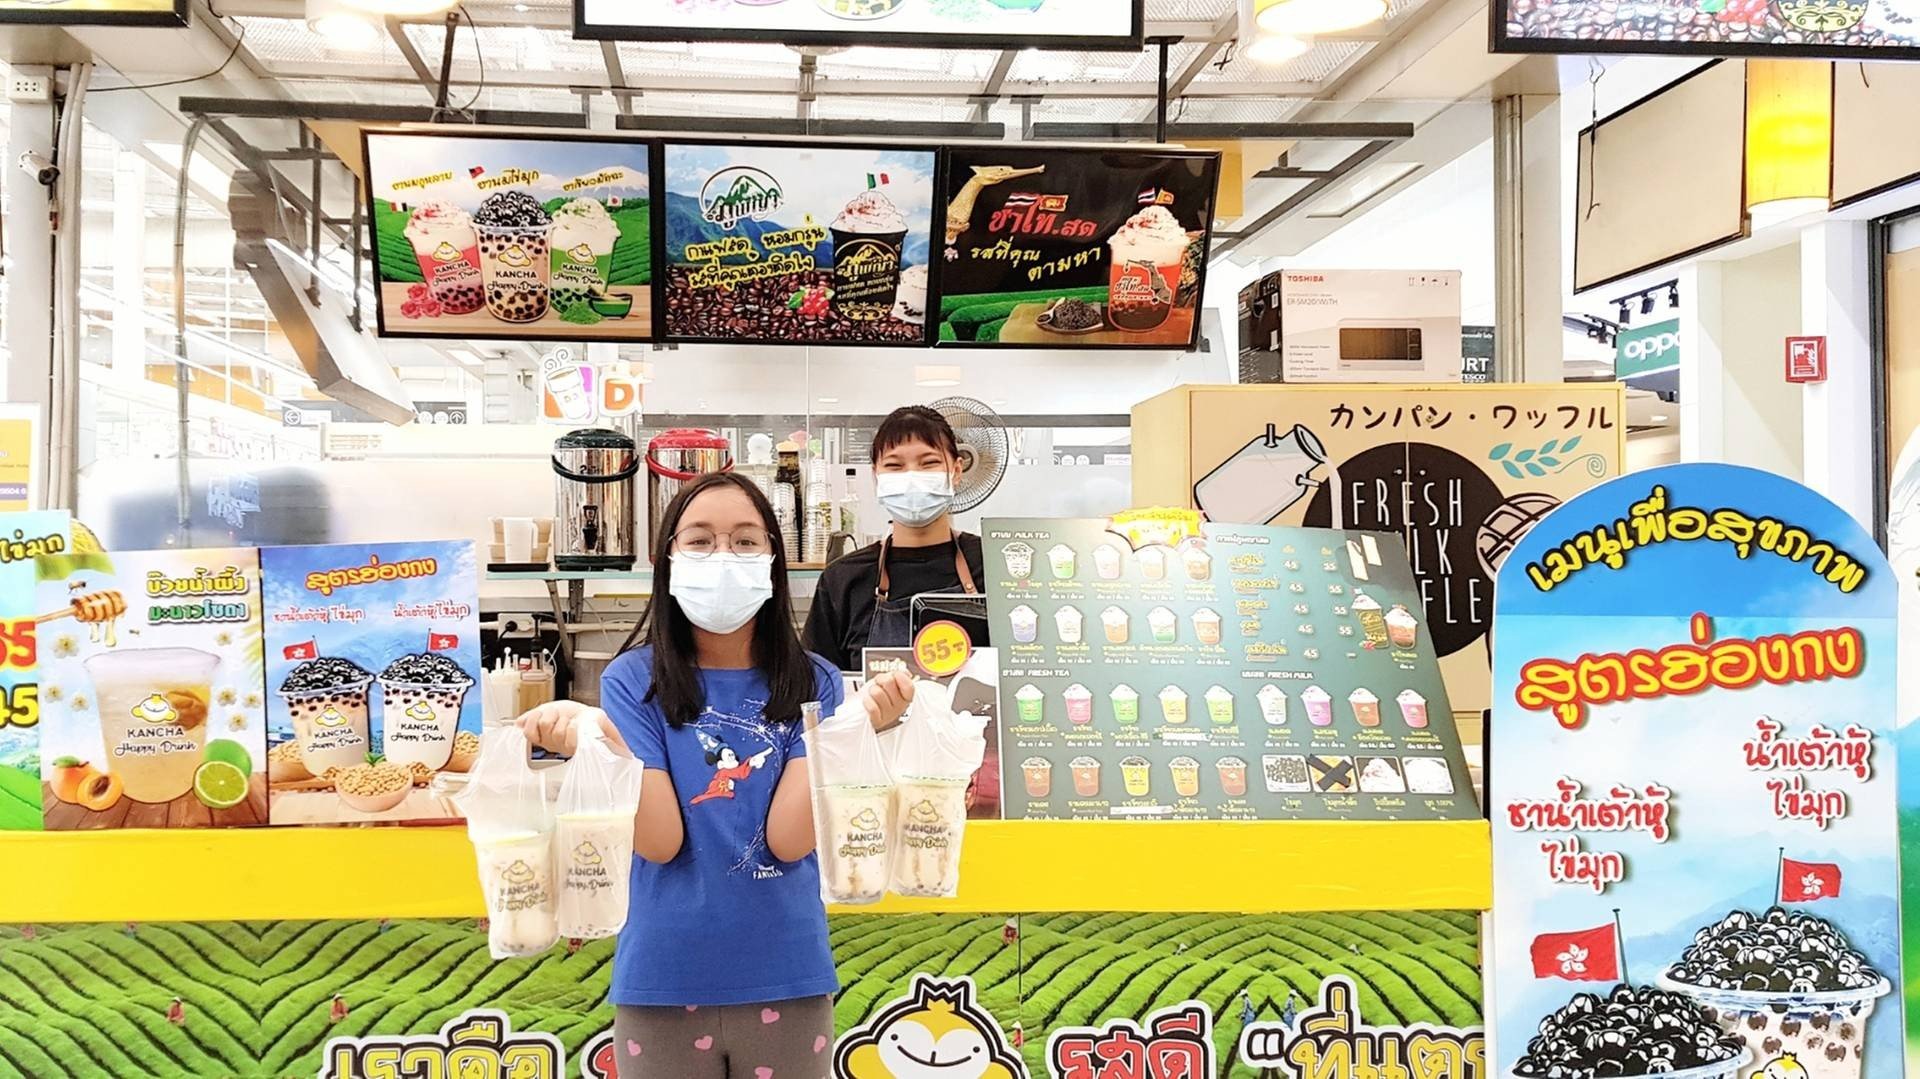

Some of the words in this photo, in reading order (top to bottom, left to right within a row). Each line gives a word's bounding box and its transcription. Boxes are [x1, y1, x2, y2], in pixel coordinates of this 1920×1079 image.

[434, 261, 470, 274] KANCHA
[562, 263, 599, 275] KANCHA
[970, 236, 1041, 269] รสที่คุณ
[1027, 247, 1101, 283] ตามหา
[495, 271, 537, 279] KANCHA
[1352, 477, 1463, 527] FRESH
[1524, 483, 1870, 594] เมนูเพื่อสุขภาพ
[305, 554, 438, 596] สูตรฮ่องกง
[147, 600, 250, 624] มะนาวโซดา
[1516, 611, 1863, 729] สูตรฮ่องกง
[126, 726, 184, 738] KANCHA
[314, 728, 353, 738] KANCHA
[400, 723, 439, 732] KANCHA
[1743, 718, 1873, 780] น้ำเต้าหู้
[1506, 779, 1670, 840] ชาน้ำเต้าหู้
[1765, 774, 1845, 830] ไข่มุก
[1541, 839, 1622, 892] ไข่มุก
